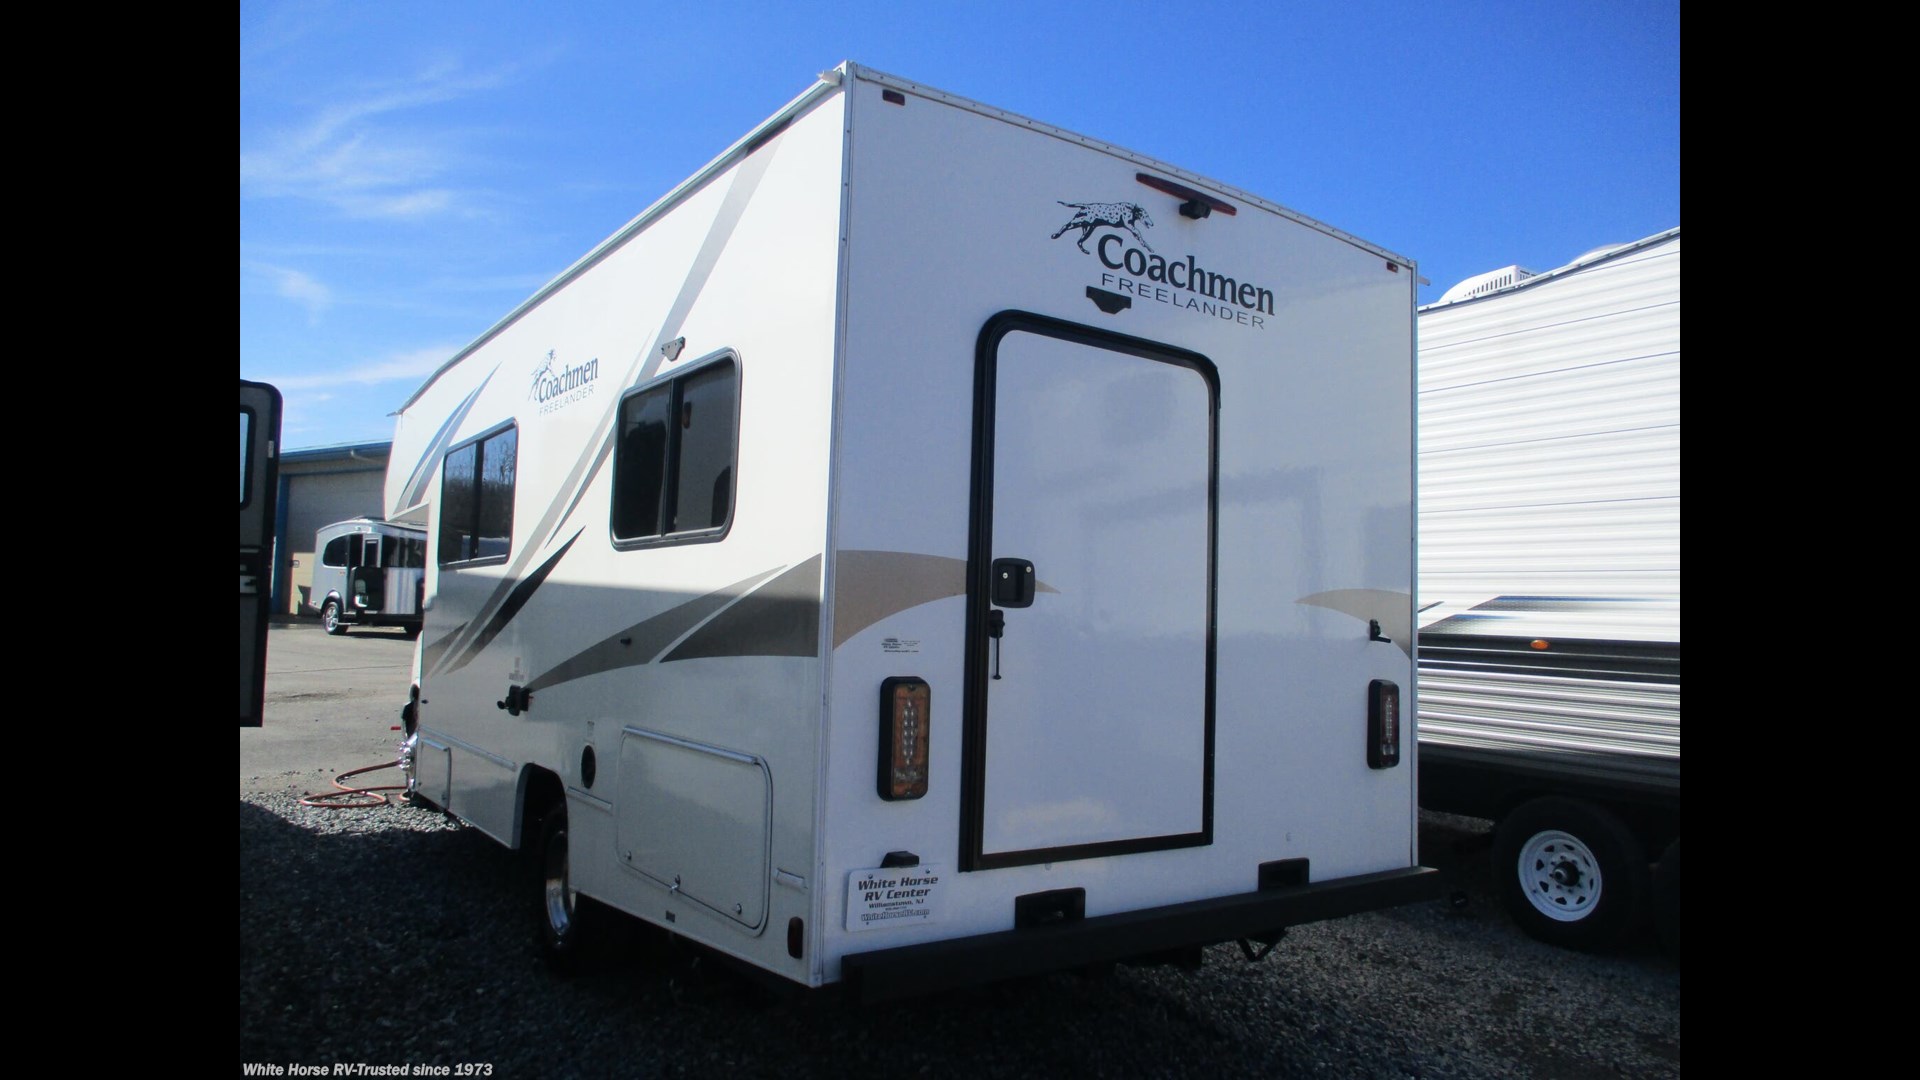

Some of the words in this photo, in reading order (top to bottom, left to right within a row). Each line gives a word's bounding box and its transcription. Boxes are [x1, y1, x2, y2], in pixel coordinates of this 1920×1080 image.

[1097, 234, 1275, 316] Coachmen
[1102, 273, 1265, 330] FREELANDER
[539, 357, 599, 403] Coachmen
[539, 384, 594, 416] FREELANDER
[858, 879, 896, 891] White
[900, 876, 939, 887] Horse
[864, 890, 883, 902] RV
[886, 888, 931, 900] Center
